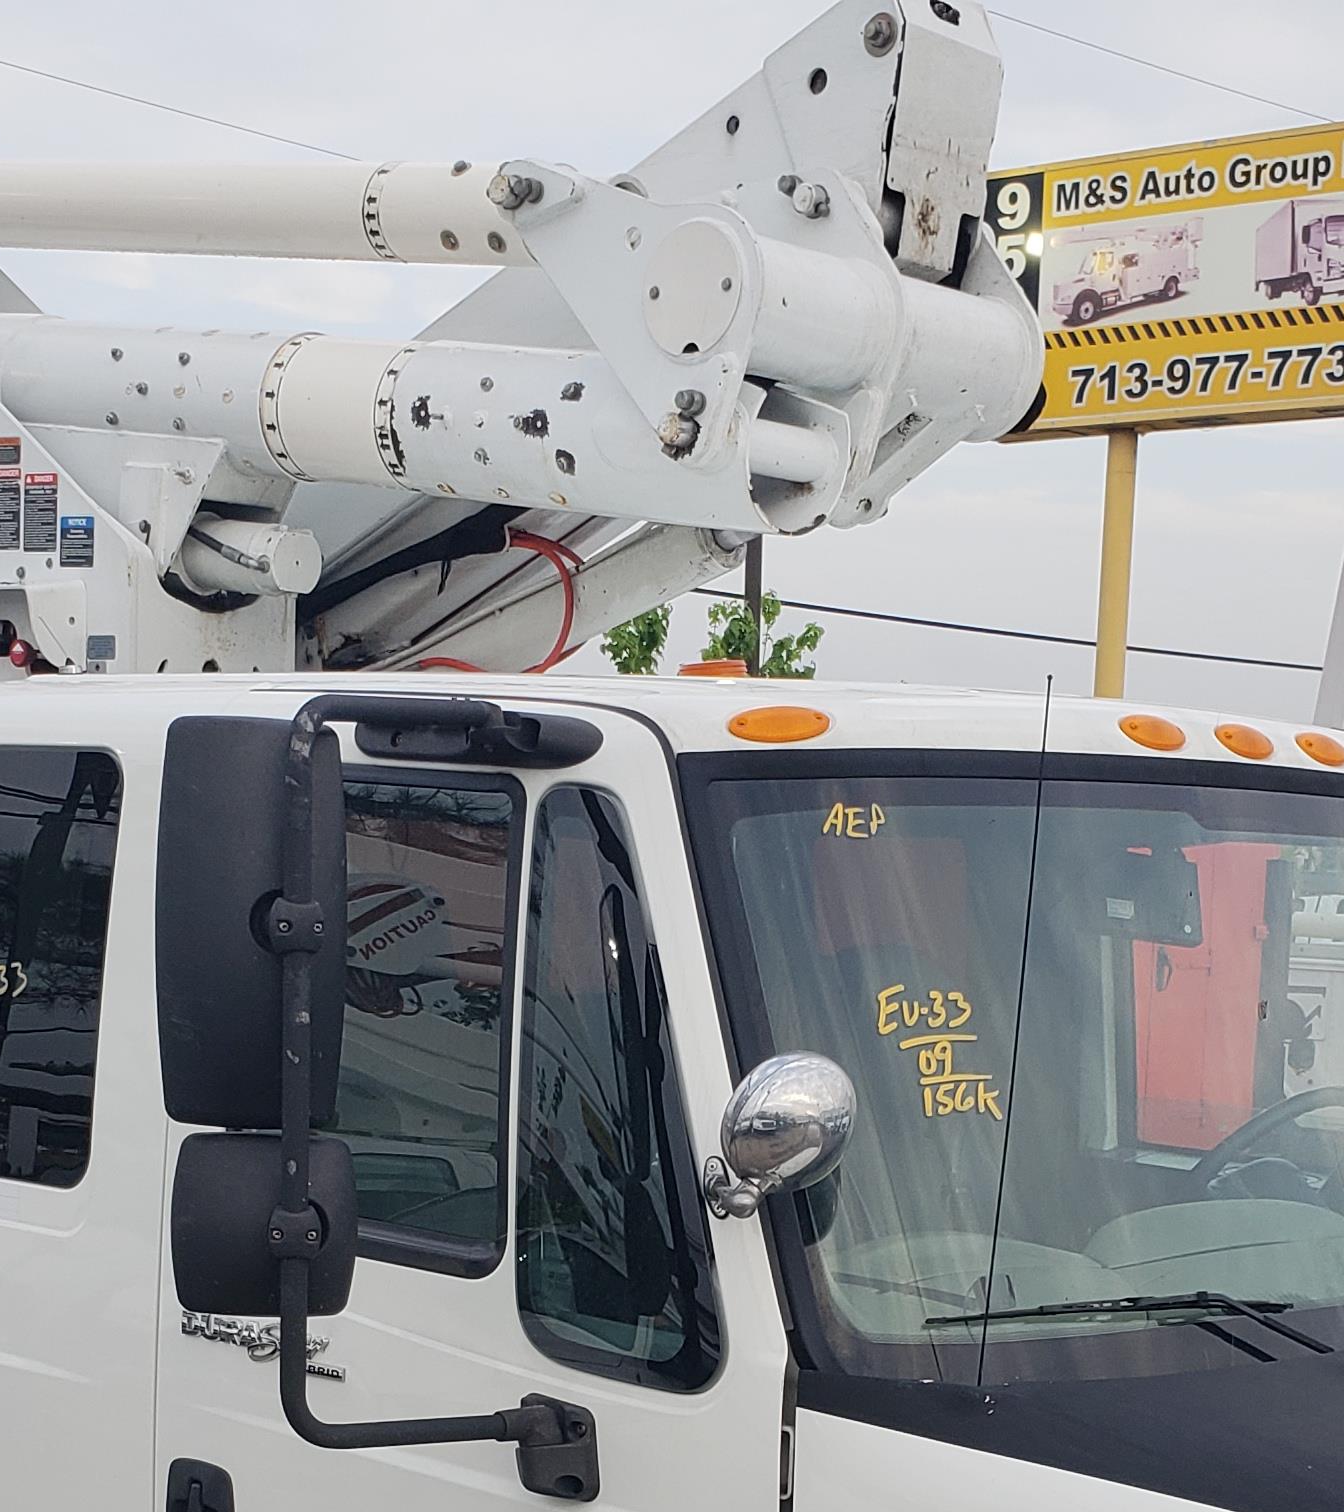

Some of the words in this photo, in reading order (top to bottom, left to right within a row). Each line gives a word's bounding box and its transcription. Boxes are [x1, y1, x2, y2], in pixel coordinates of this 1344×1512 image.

[996, 181, 1032, 230] 9
[1054, 174, 1130, 214] M&S
[1139, 162, 1216, 202] Auto
[1227, 152, 1332, 190] Group
